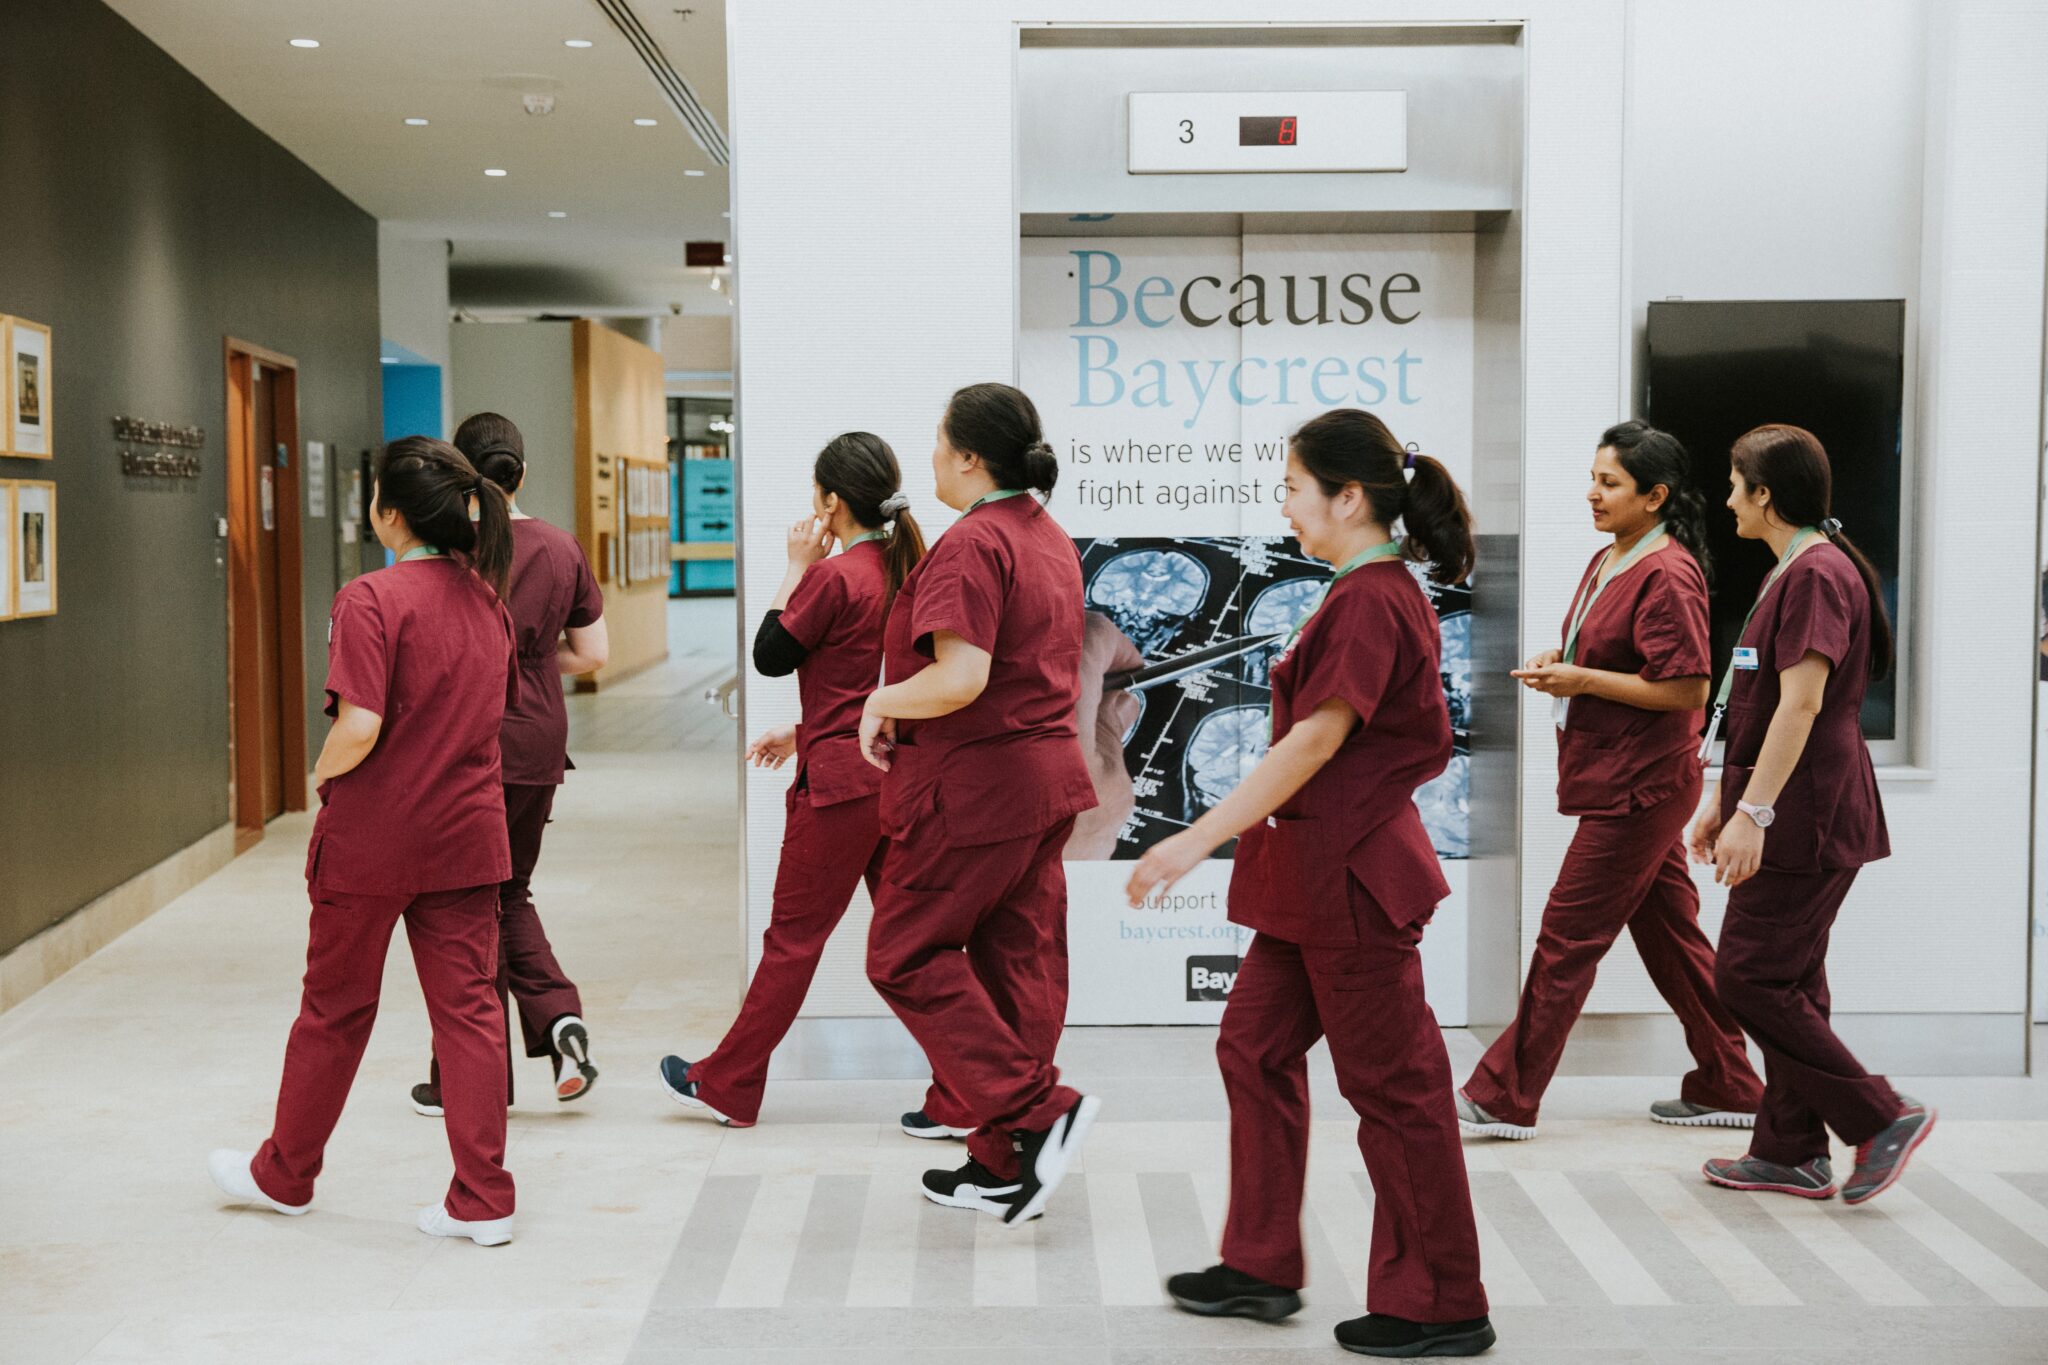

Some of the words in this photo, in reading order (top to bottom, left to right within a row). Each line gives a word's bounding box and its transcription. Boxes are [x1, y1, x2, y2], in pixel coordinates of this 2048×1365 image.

[1178, 119, 1195, 145] 3
[1069, 249, 1422, 329] Because
[1070, 334, 1423, 430] Baycrest
[1071, 438, 1092, 464] is
[1103, 438, 1193, 464] where
[1204, 442, 1243, 464] we
[1254, 435, 1284, 462] wi
[1077, 479, 1145, 512] fight
[1156, 478, 1262, 512] against
